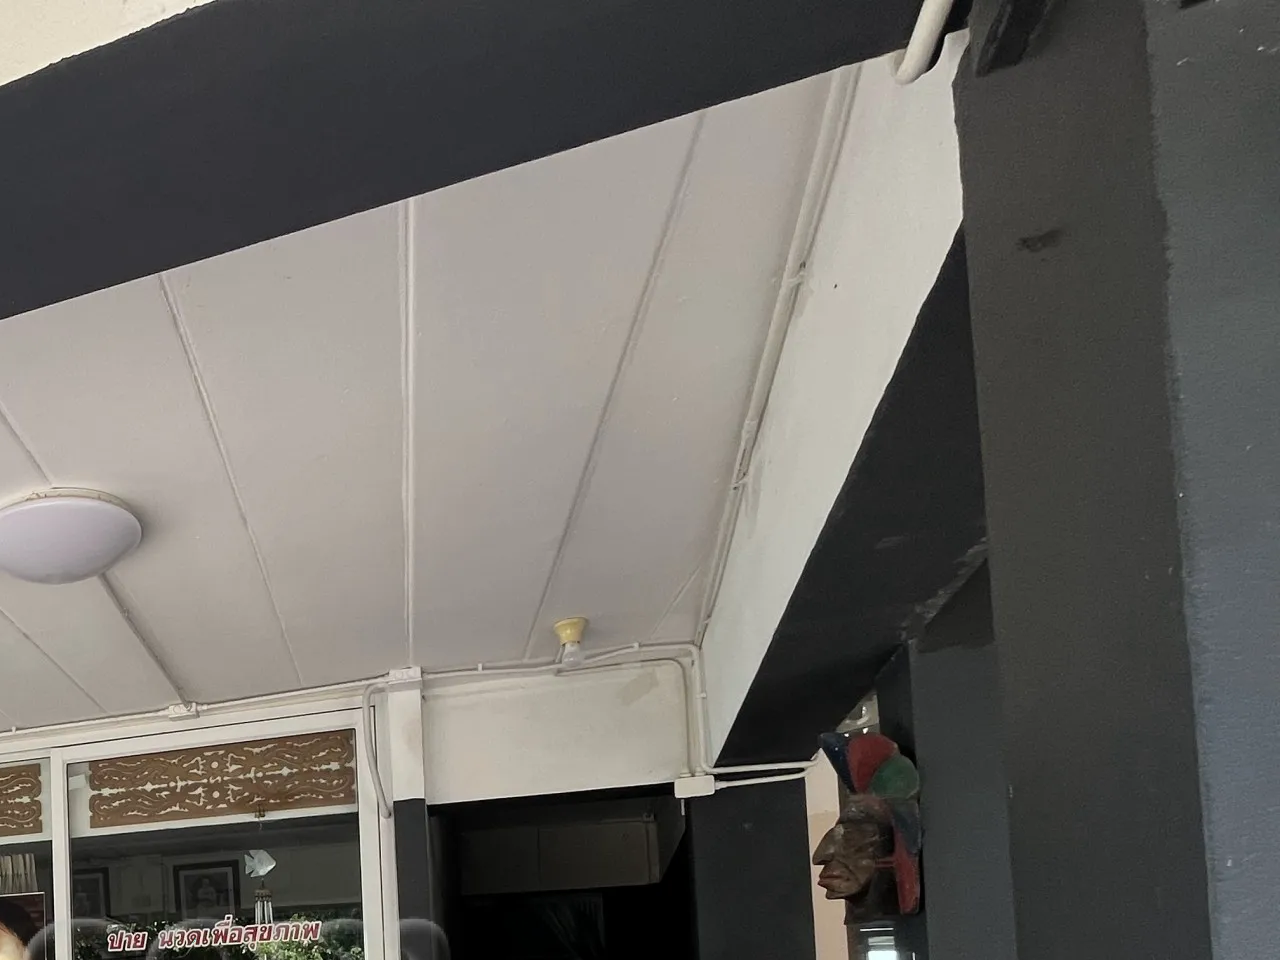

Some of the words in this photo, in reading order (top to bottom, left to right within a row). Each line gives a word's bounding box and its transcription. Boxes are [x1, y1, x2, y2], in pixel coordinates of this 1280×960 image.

[107, 930, 148, 952] ปาย
[158, 914, 322, 951] นวดเพื่อสุขภาพ
